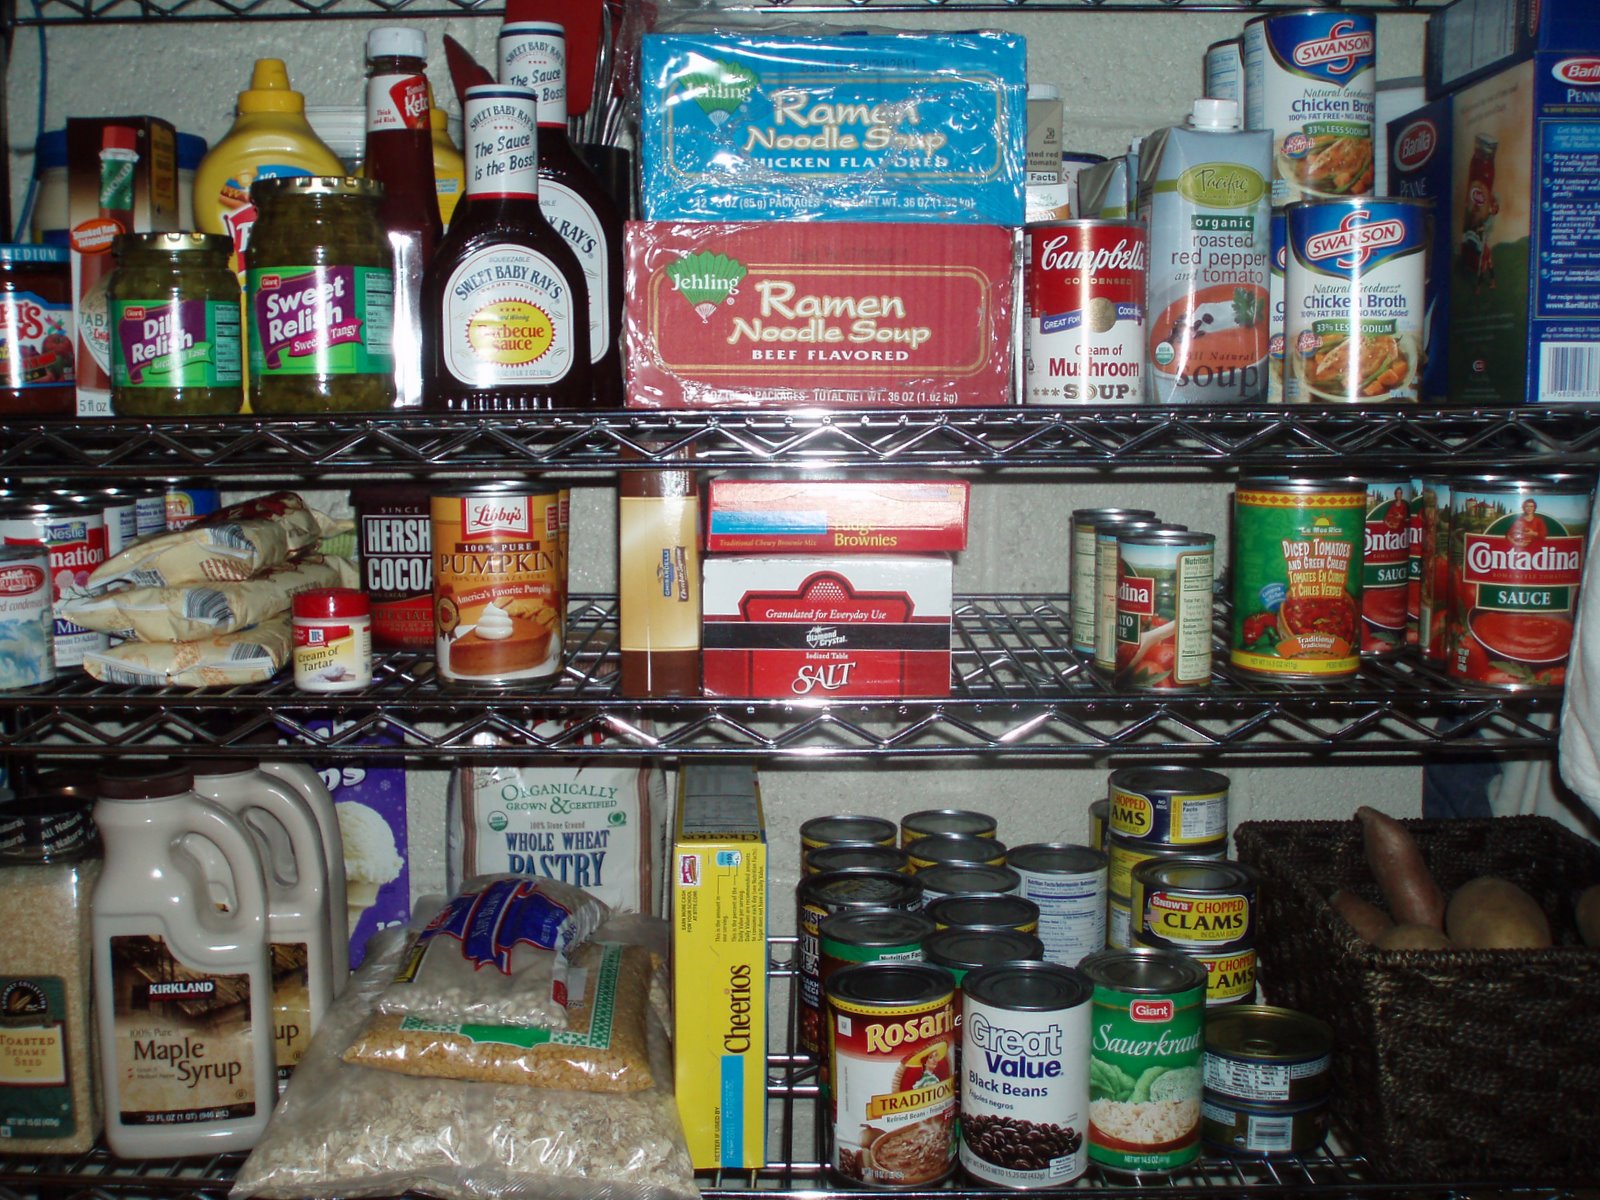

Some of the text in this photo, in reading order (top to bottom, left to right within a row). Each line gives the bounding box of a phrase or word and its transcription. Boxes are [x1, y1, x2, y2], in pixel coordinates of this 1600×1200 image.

[506, 41, 549, 66] SWEET BABY
[1301, 37, 1370, 61] SWANSON
[511, 67, 561, 87] The Sauce
[1303, 88, 1341, 98] Natural
[771, 90, 920, 128] Ramen
[1292, 98, 1349, 112] Chicken
[470, 110, 492, 132] SWEET
[493, 105, 516, 116] BABY
[517, 112, 534, 133] RAY'S
[1308, 126, 1325, 134] 33%
[474, 134, 530, 159] The Sauce
[743, 127, 947, 158] Noodle Soup
[1402, 129, 1431, 159] Barilla
[474, 151, 535, 181] is the Boss!
[1031, 173, 1057, 181] Facts
[1196, 169, 1248, 193] Pacific
[1400, 177, 1427, 197] PENNE
[770, 199, 819, 208] PACKAGES
[1196, 218, 1252, 230] organic
[559, 220, 597, 254] RAY'S
[1193, 233, 1254, 248] roasted
[1313, 226, 1396, 253] SWANSON
[1171, 251, 1267, 269] red pepper
[455, 265, 563, 301] SWEET BABY RAY'S
[671, 272, 740, 295] Jehling
[1175, 269, 1264, 283] and tomato
[266, 275, 345, 319] Sweet
[1313, 284, 1350, 294] Natural
[755, 280, 906, 319] Ramen
[1367, 295, 1406, 308] Broth
[331, 325, 357, 338] Tangy
[727, 317, 932, 349] Noodle Soup
[1044, 320, 1067, 331] GREAT
[752, 349, 910, 361] BEEF FLAVORED
[1112, 344, 1122, 356] of
[1176, 365, 1258, 398] soup
[80, 401, 107, 412] 5 oz
[847, 391, 864, 401] NET
[867, 392, 885, 402] WT.
[888, 392, 900, 401] 36
[902, 392, 914, 401] OZ
[943, 391, 959, 404] kg)
[471, 504, 523, 527] Libby's
[367, 519, 431, 553] HERSH
[834, 533, 897, 547] Brownies
[50, 546, 103, 568] nation
[464, 543, 533, 553] 100% PURE
[1282, 538, 1351, 558] DICED TOMATOES
[440, 551, 555, 576] PUMPKIN
[1288, 558, 1325, 571] AND GREEN
[1467, 541, 1579, 574] Contadina
[368, 559, 432, 590] COCOA
[1289, 571, 1317, 583] TOMATES
[456, 586, 523, 605] America's Favorite
[1298, 585, 1320, 597] CHILES
[1498, 591, 1551, 606] SAUCE
[765, 608, 886, 622] Granulated for Everyday Use
[806, 630, 837, 642] Diamond
[820, 636, 846, 647] Crystal
[1297, 636, 1335, 644] Traditional
[297, 645, 339, 663] Cream of
[304, 659, 334, 672] Tartar
[791, 661, 856, 694] SALT
[501, 783, 618, 801] ORGANICALLY
[506, 796, 617, 814] GROWN & CERTIFIED
[1113, 794, 1146, 811] HOPPED
[41, 813, 83, 840] All Natural
[56, 827, 85, 849] Natural
[506, 830, 610, 852] WHOLE WHEAT
[507, 851, 607, 887] PASTRY
[1153, 897, 1244, 914] SNOW'S CHOPPED
[1163, 912, 1243, 931] CLAMS
[149, 982, 214, 995] KIRKLAND
[724, 964, 751, 1054] Cheerios
[1136, 1005, 1169, 1018] Giant
[0, 1035, 55, 1046] TOASTED
[130, 1028, 172, 1038] 100% Pure
[968, 1012, 1062, 1057] Great
[1093, 1024, 1201, 1057] Sauerkraut
[4, 1047, 47, 1056] SESAME
[134, 1037, 204, 1067] Maple
[15, 1057, 42, 1067] SEED
[985, 1051, 1062, 1079] Value
[177, 1061, 242, 1088] Syrup
[969, 1070, 1048, 1098] Black Beans
[988, 1098, 1014, 1110] negros
[887, 1111, 926, 1123] Refried Beans
